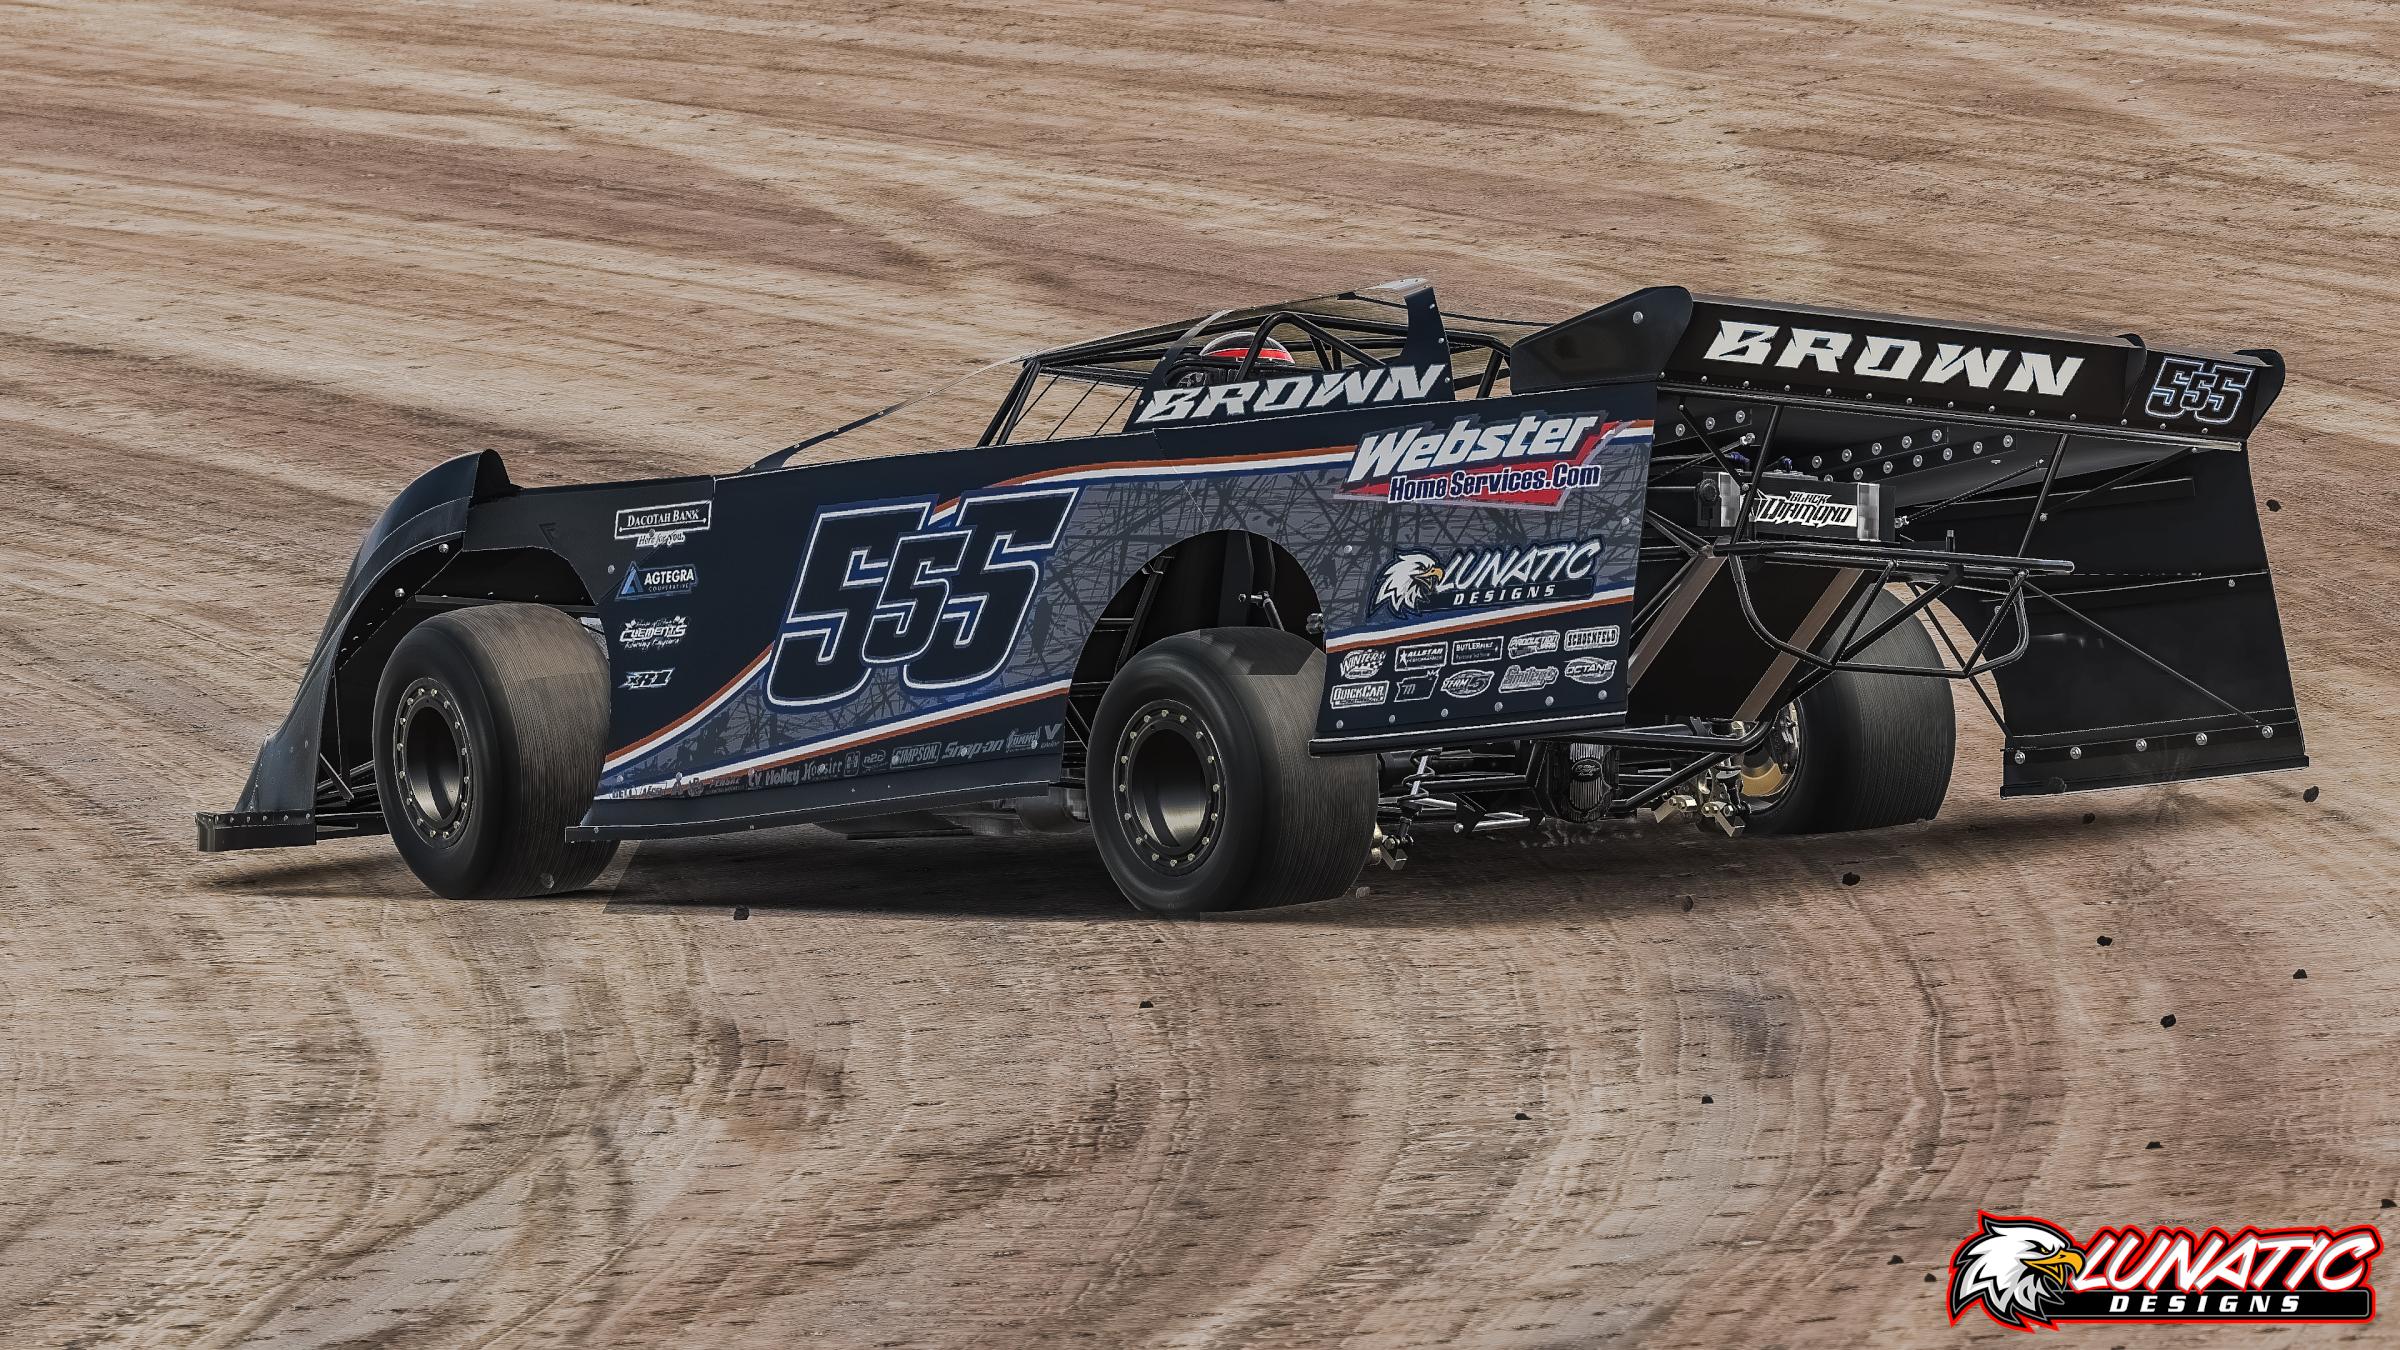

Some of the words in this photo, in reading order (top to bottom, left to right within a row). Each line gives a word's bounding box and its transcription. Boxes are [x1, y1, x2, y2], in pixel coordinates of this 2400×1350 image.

[1703, 320, 2085, 396] BROWN
[1134, 364, 1446, 424] BROWN
[2144, 356, 2255, 425] 555
[1348, 415, 1600, 483] Webster
[1388, 475, 1447, 503] Home
[1450, 462, 1601, 497] Services.Com
[1788, 491, 1832, 504] BLACK
[627, 512, 671, 527] DACOTAH
[673, 508, 699, 522] BANK
[643, 568, 695, 585] AGTEGRA
[1435, 540, 1601, 592] LUNATIC
[766, 487, 1080, 707] 555
[1453, 583, 1556, 606] DESIGNS
[619, 624, 688, 642] CLEMENTS
[1567, 629, 1616, 647] SCHOENFELD
[801, 758, 843, 781] Hosier
